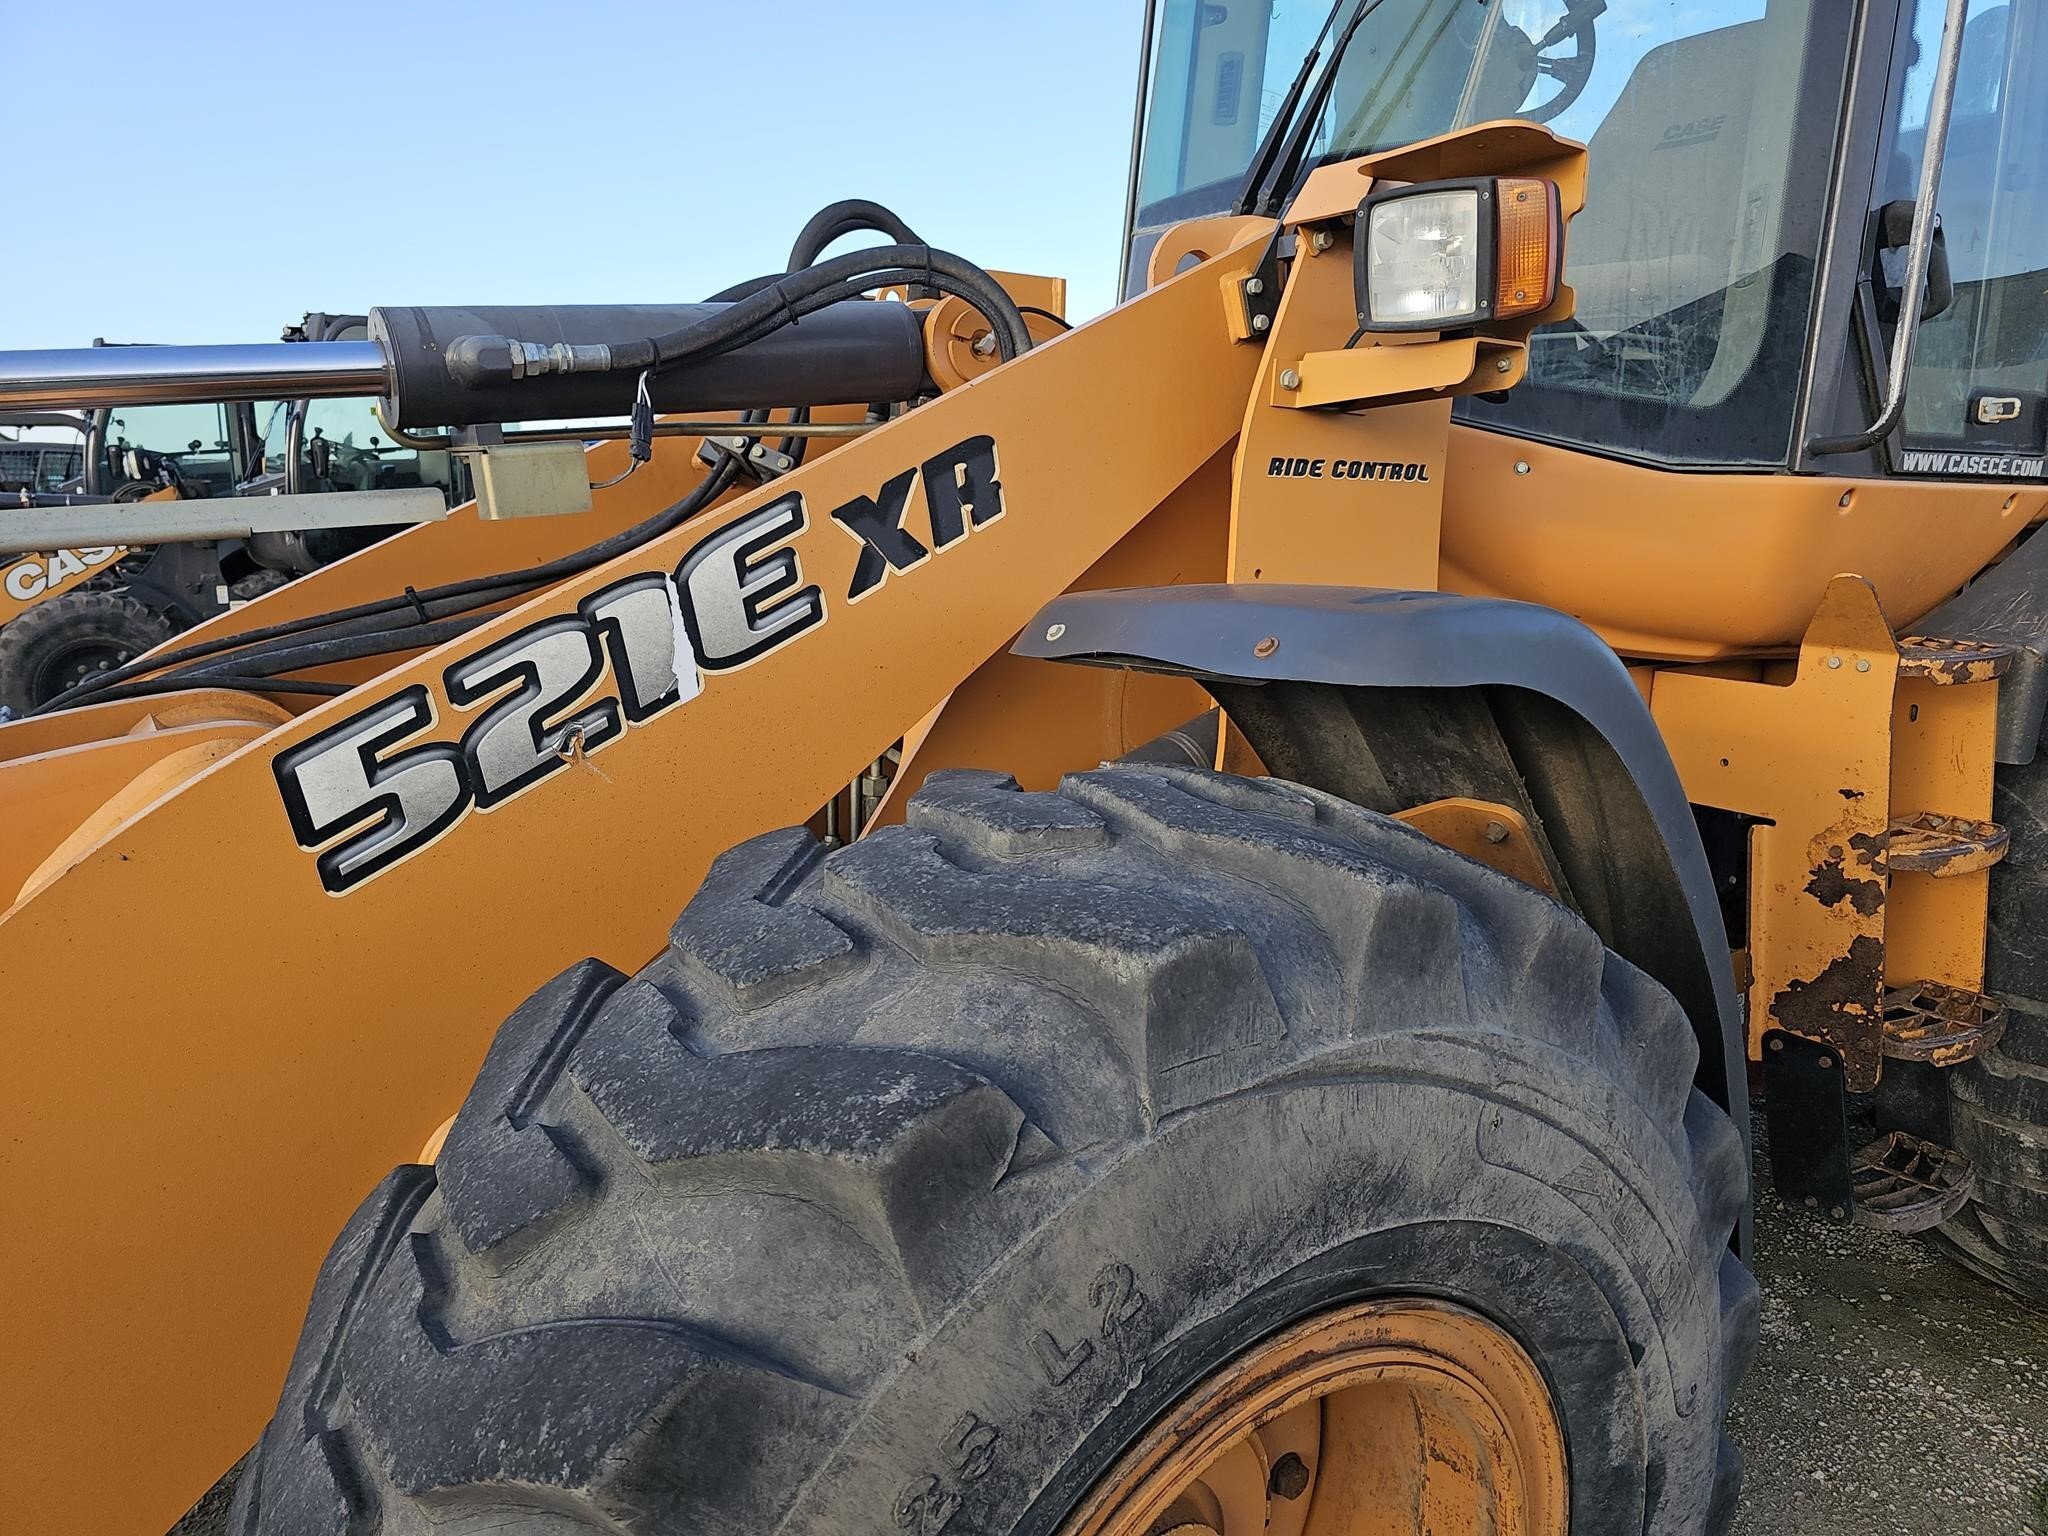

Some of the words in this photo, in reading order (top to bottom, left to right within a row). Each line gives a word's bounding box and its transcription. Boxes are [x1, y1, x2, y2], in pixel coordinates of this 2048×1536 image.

[1267, 457, 1326, 479] RIDE
[1330, 459, 1430, 482] CONTROL
[1902, 453, 2044, 477] WWW.CASECE.COM
[5, 545, 127, 601] CAS
[272, 490, 829, 897] 521E
[830, 435, 1006, 605] XR
